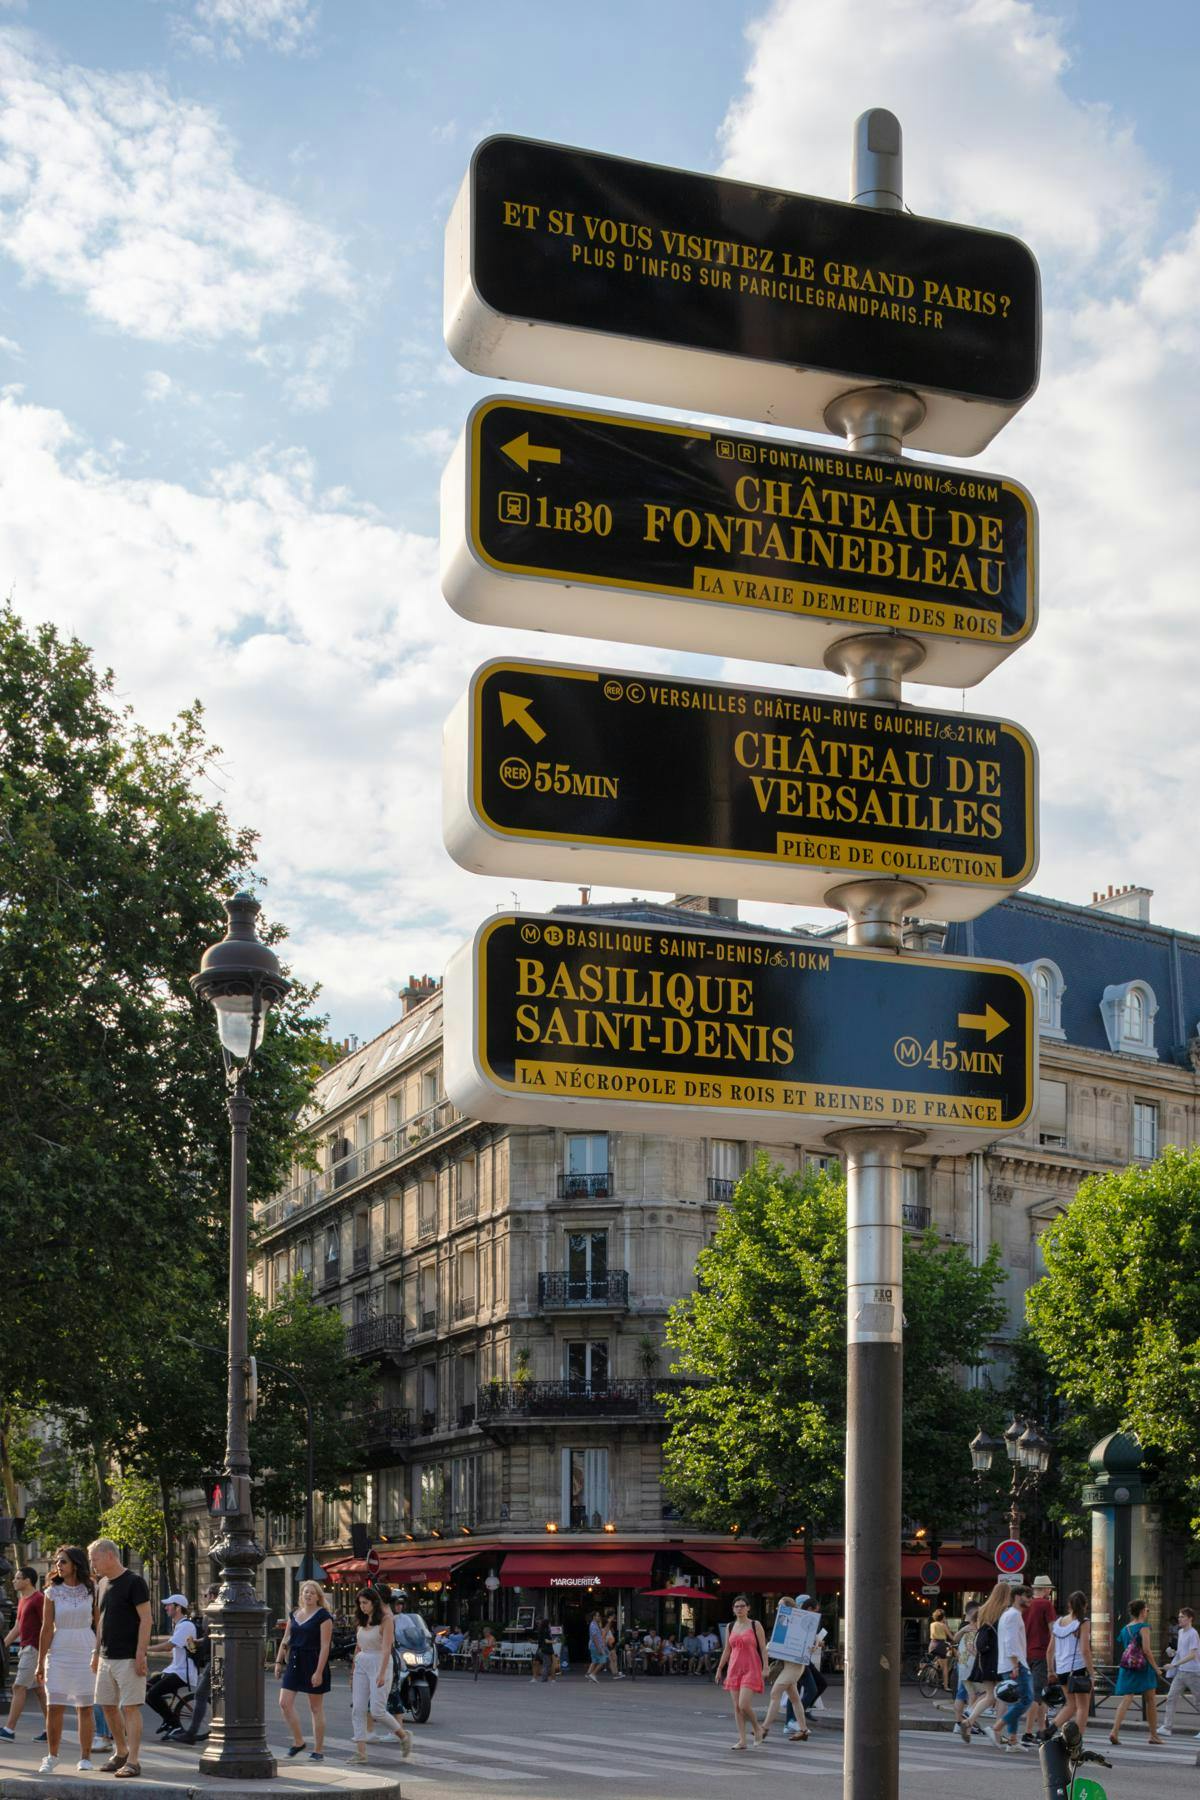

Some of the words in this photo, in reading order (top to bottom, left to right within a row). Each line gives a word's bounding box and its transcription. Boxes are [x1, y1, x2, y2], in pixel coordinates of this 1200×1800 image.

[504, 201, 540, 229] ET
[548, 210, 574, 236] SI
[583, 216, 652, 250] VOUS
[661, 230, 774, 273] VISITIEZ
[783, 253, 814, 281] LE
[824, 262, 914, 298] GRAND
[572, 244, 615, 268] PLUS
[624, 253, 691, 282] D'INFOS
[700, 267, 731, 289] SUR
[739, 274, 942, 328] PARICILEGRANDPARIS.FR
[735, 476, 935, 540] CHÂTEAU
[948, 510, 1003, 553] DE
[959, 482, 998, 502] 68KM
[644, 504, 1004, 595] FONTAINEBLEAU
[700, 575, 724, 594] LA
[733, 580, 793, 604] VRAIE
[802, 590, 900, 620] DEMEURE
[909, 606, 945, 627] DES
[953, 613, 996, 635] ROIS
[650, 687, 746, 714] VERSAILLES
[754, 699, 867, 729] CHÂTEAU-RIVE
[958, 726, 996, 746] 21KM
[734, 729, 933, 788] CHÂTEAU
[947, 757, 1001, 797] DE
[749, 776, 1002, 838] VERSAILLES
[784, 838, 840, 861] PIÈCE
[848, 847, 873, 864] DE
[881, 851, 996, 877] COLLECTION
[567, 929, 652, 953] BASILIQUE
[790, 951, 830, 971] 10KM
[516, 958, 753, 1018] BASILIQUE
[516, 1004, 794, 1064] SAINT-DENIS
[521, 1068, 546, 1085] LA
[555, 1069, 675, 1095] NÉCROPOLE
[684, 1080, 722, 1099] DES
[731, 1085, 774, 1103] ROIS
[783, 1089, 806, 1105] ET
[815, 1092, 884, 1112] REINES
[892, 1098, 916, 1114] DE
[925, 1101, 997, 1121] FRANCE
